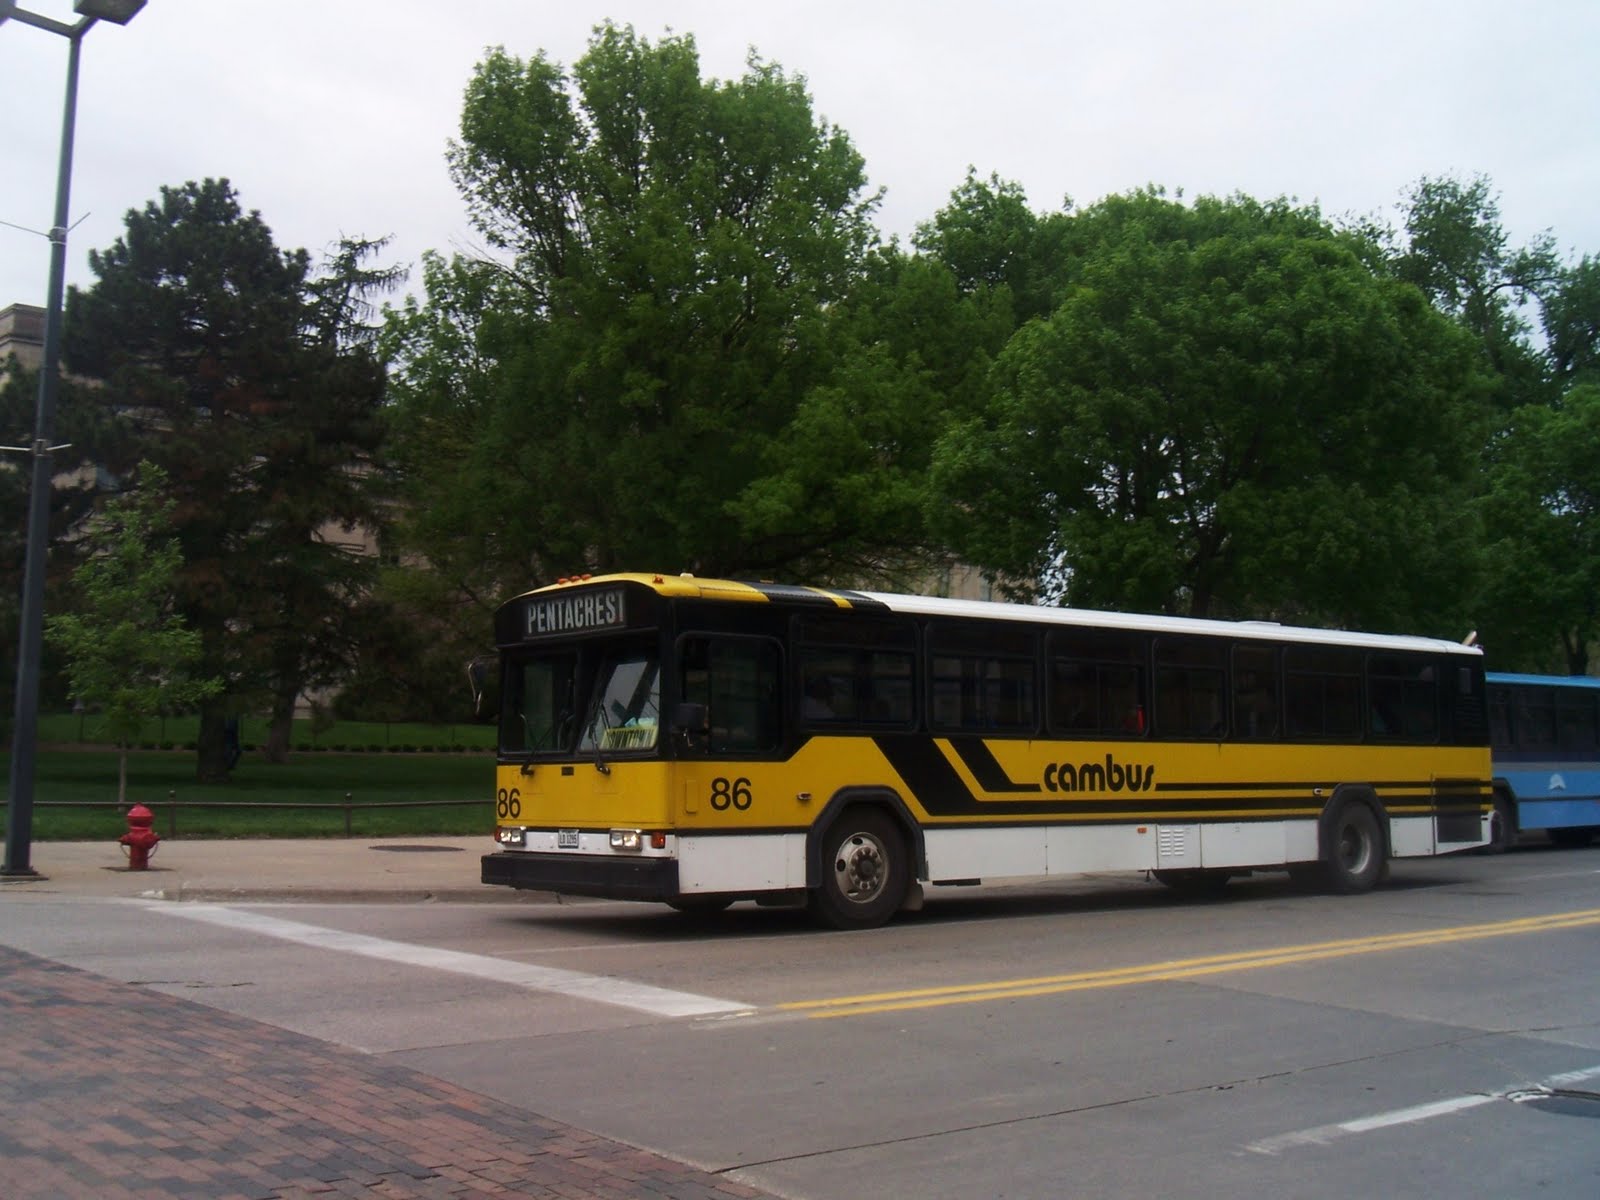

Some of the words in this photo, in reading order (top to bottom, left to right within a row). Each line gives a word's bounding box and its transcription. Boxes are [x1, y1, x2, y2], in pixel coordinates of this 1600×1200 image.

[527, 590, 624, 634] PENTACREST
[1044, 754, 1154, 792] cambus
[498, 788, 521, 818] 86
[710, 777, 752, 811] 86
